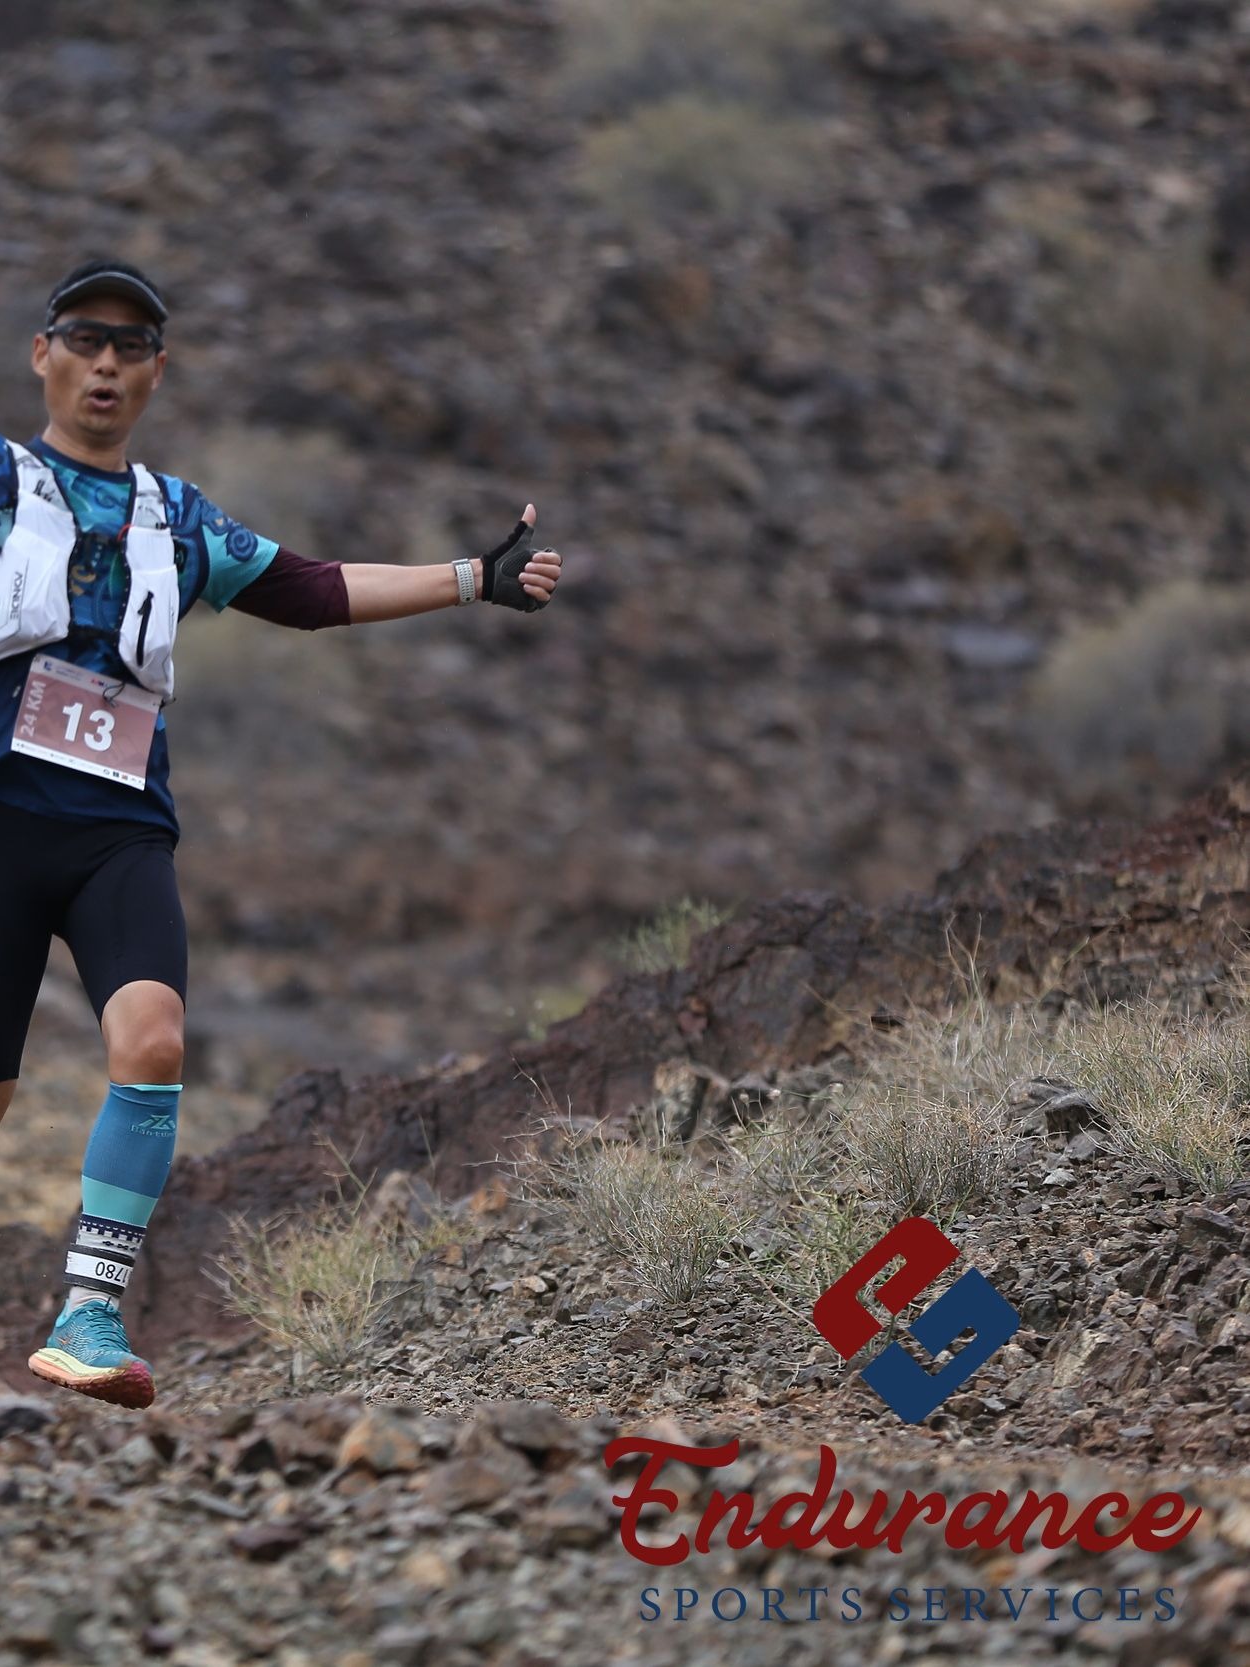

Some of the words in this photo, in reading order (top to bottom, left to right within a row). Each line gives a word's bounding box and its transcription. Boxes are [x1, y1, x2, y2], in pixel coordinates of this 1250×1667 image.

[26, 680, 47, 711] KM
[20, 713, 38, 737] 24
[62, 702, 116, 752] 13
[95, 1261, 129, 1283] 1780
